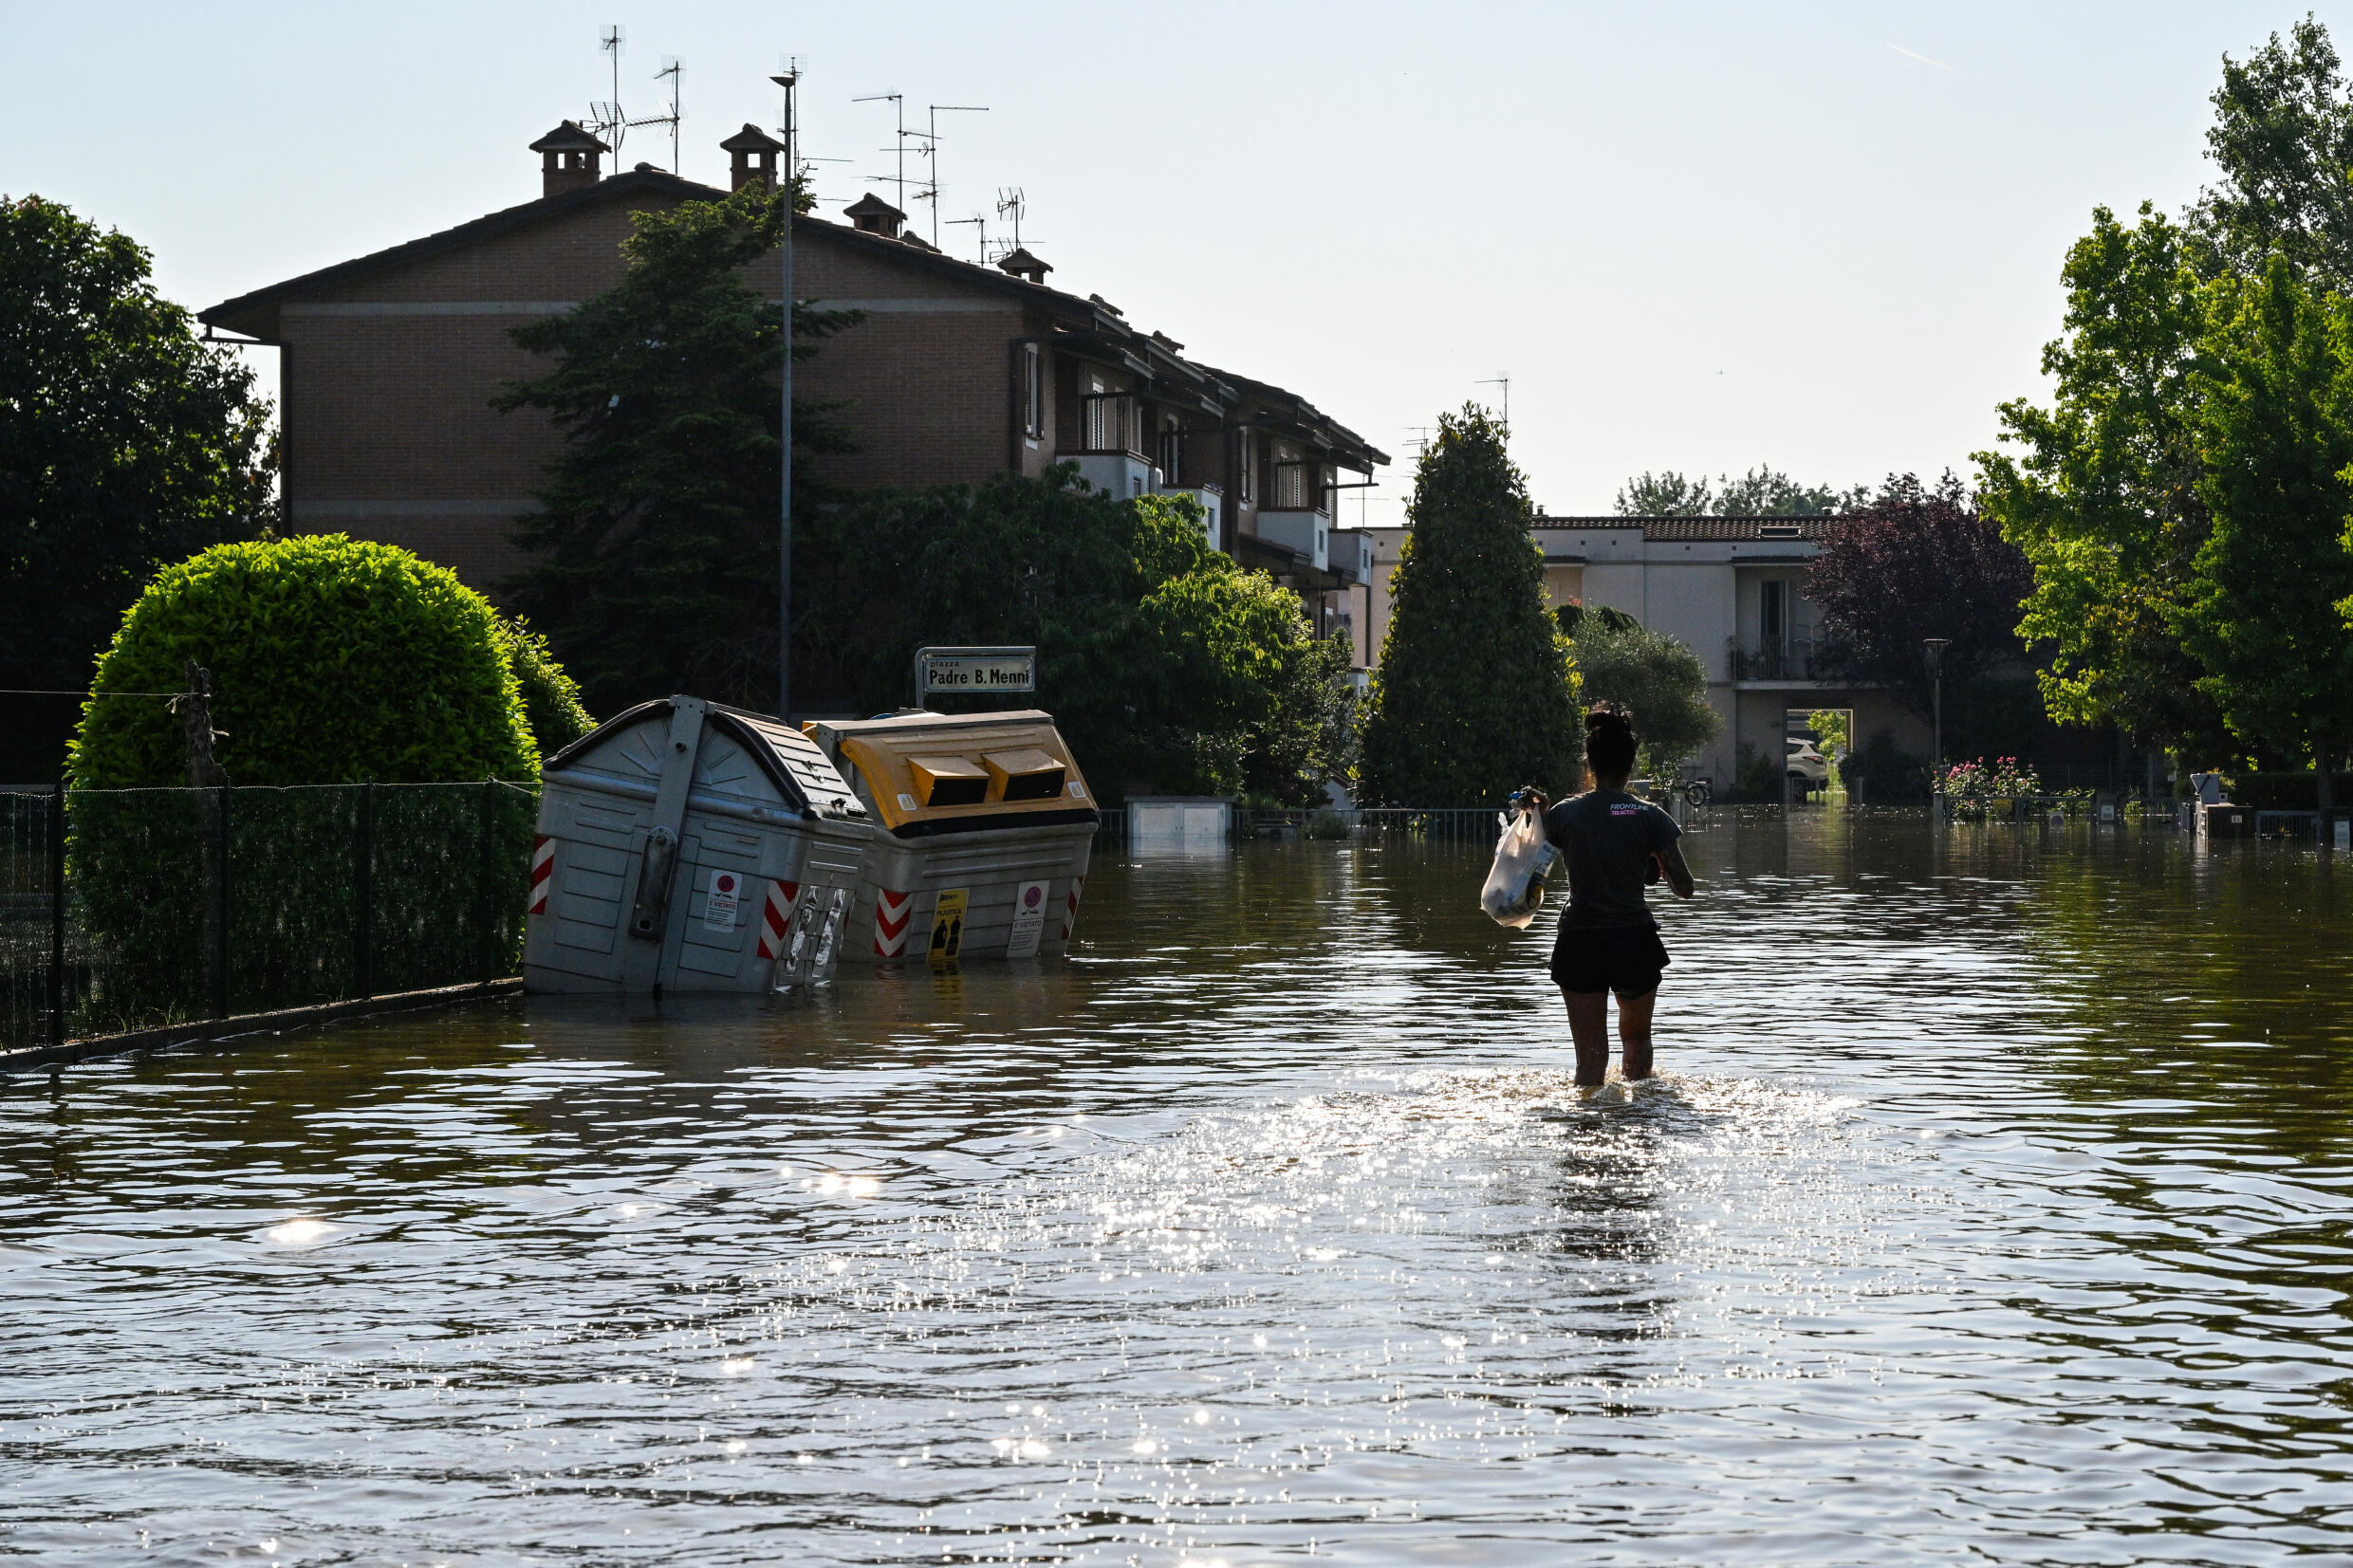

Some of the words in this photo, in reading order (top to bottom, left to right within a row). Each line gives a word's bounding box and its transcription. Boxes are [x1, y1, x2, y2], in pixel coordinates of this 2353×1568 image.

[930, 669, 968, 684] Padre
[974, 669, 987, 684] B.
[990, 669, 1029, 684] Menni
